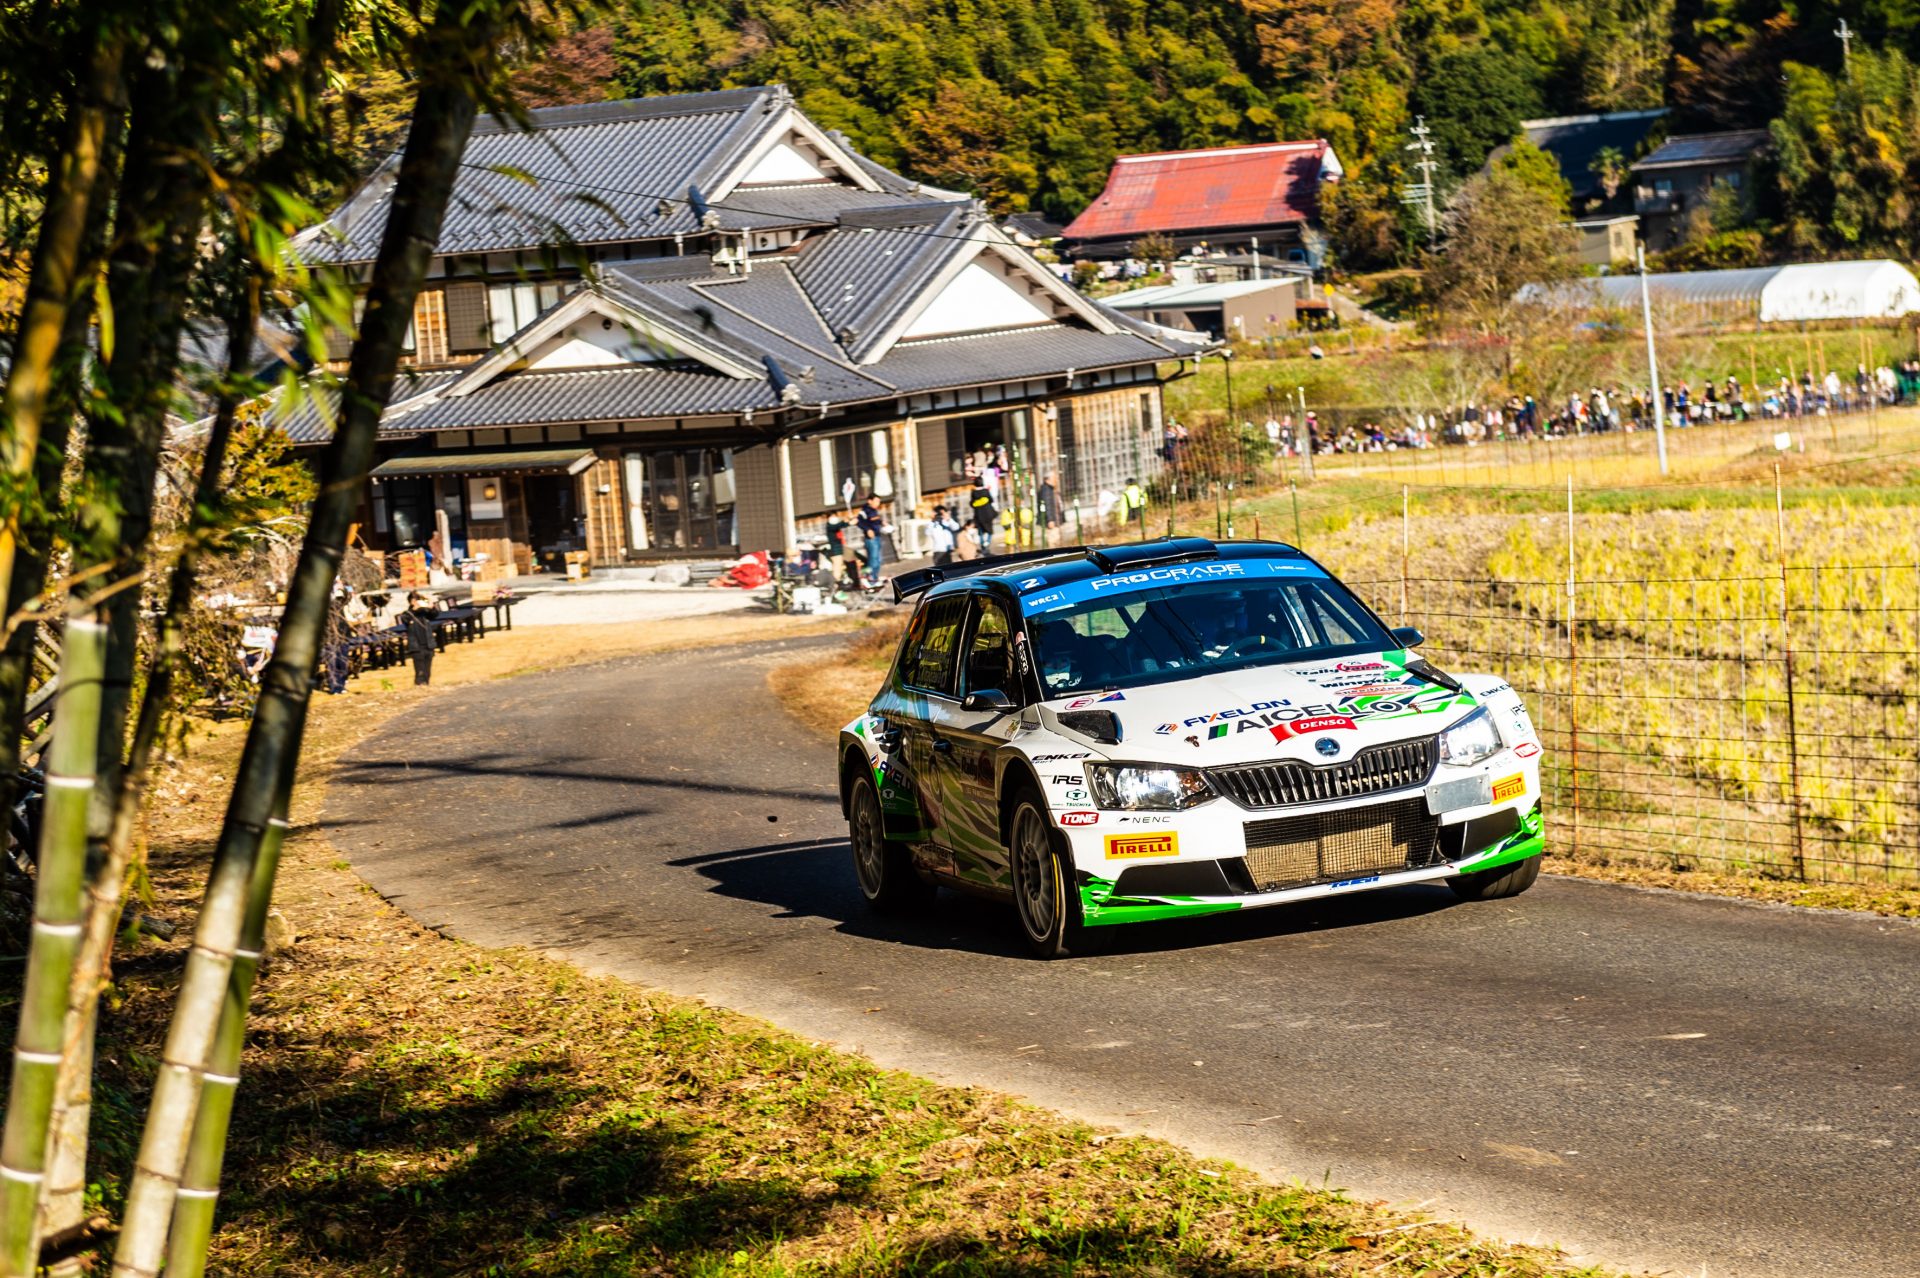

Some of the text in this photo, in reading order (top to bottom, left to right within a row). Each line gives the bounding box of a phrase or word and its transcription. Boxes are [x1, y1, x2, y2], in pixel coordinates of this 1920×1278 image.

[1091, 563, 1242, 591] PROGRADE
[1174, 570, 1246, 581] DIGITAL
[1021, 578, 1040, 589] 2
[1028, 594, 1059, 607] WRC2
[1183, 698, 1292, 728] FIXELON
[1236, 701, 1403, 734] AICELLO
[1300, 718, 1347, 730] DENSO
[1031, 752, 1093, 762] ENKEI
[1052, 775, 1083, 786] IRS
[1492, 777, 1524, 801] PIRELLI
[1063, 813, 1098, 824] TONE
[1132, 816, 1171, 824] NENC
[1111, 836, 1172, 855] PIRELLI
